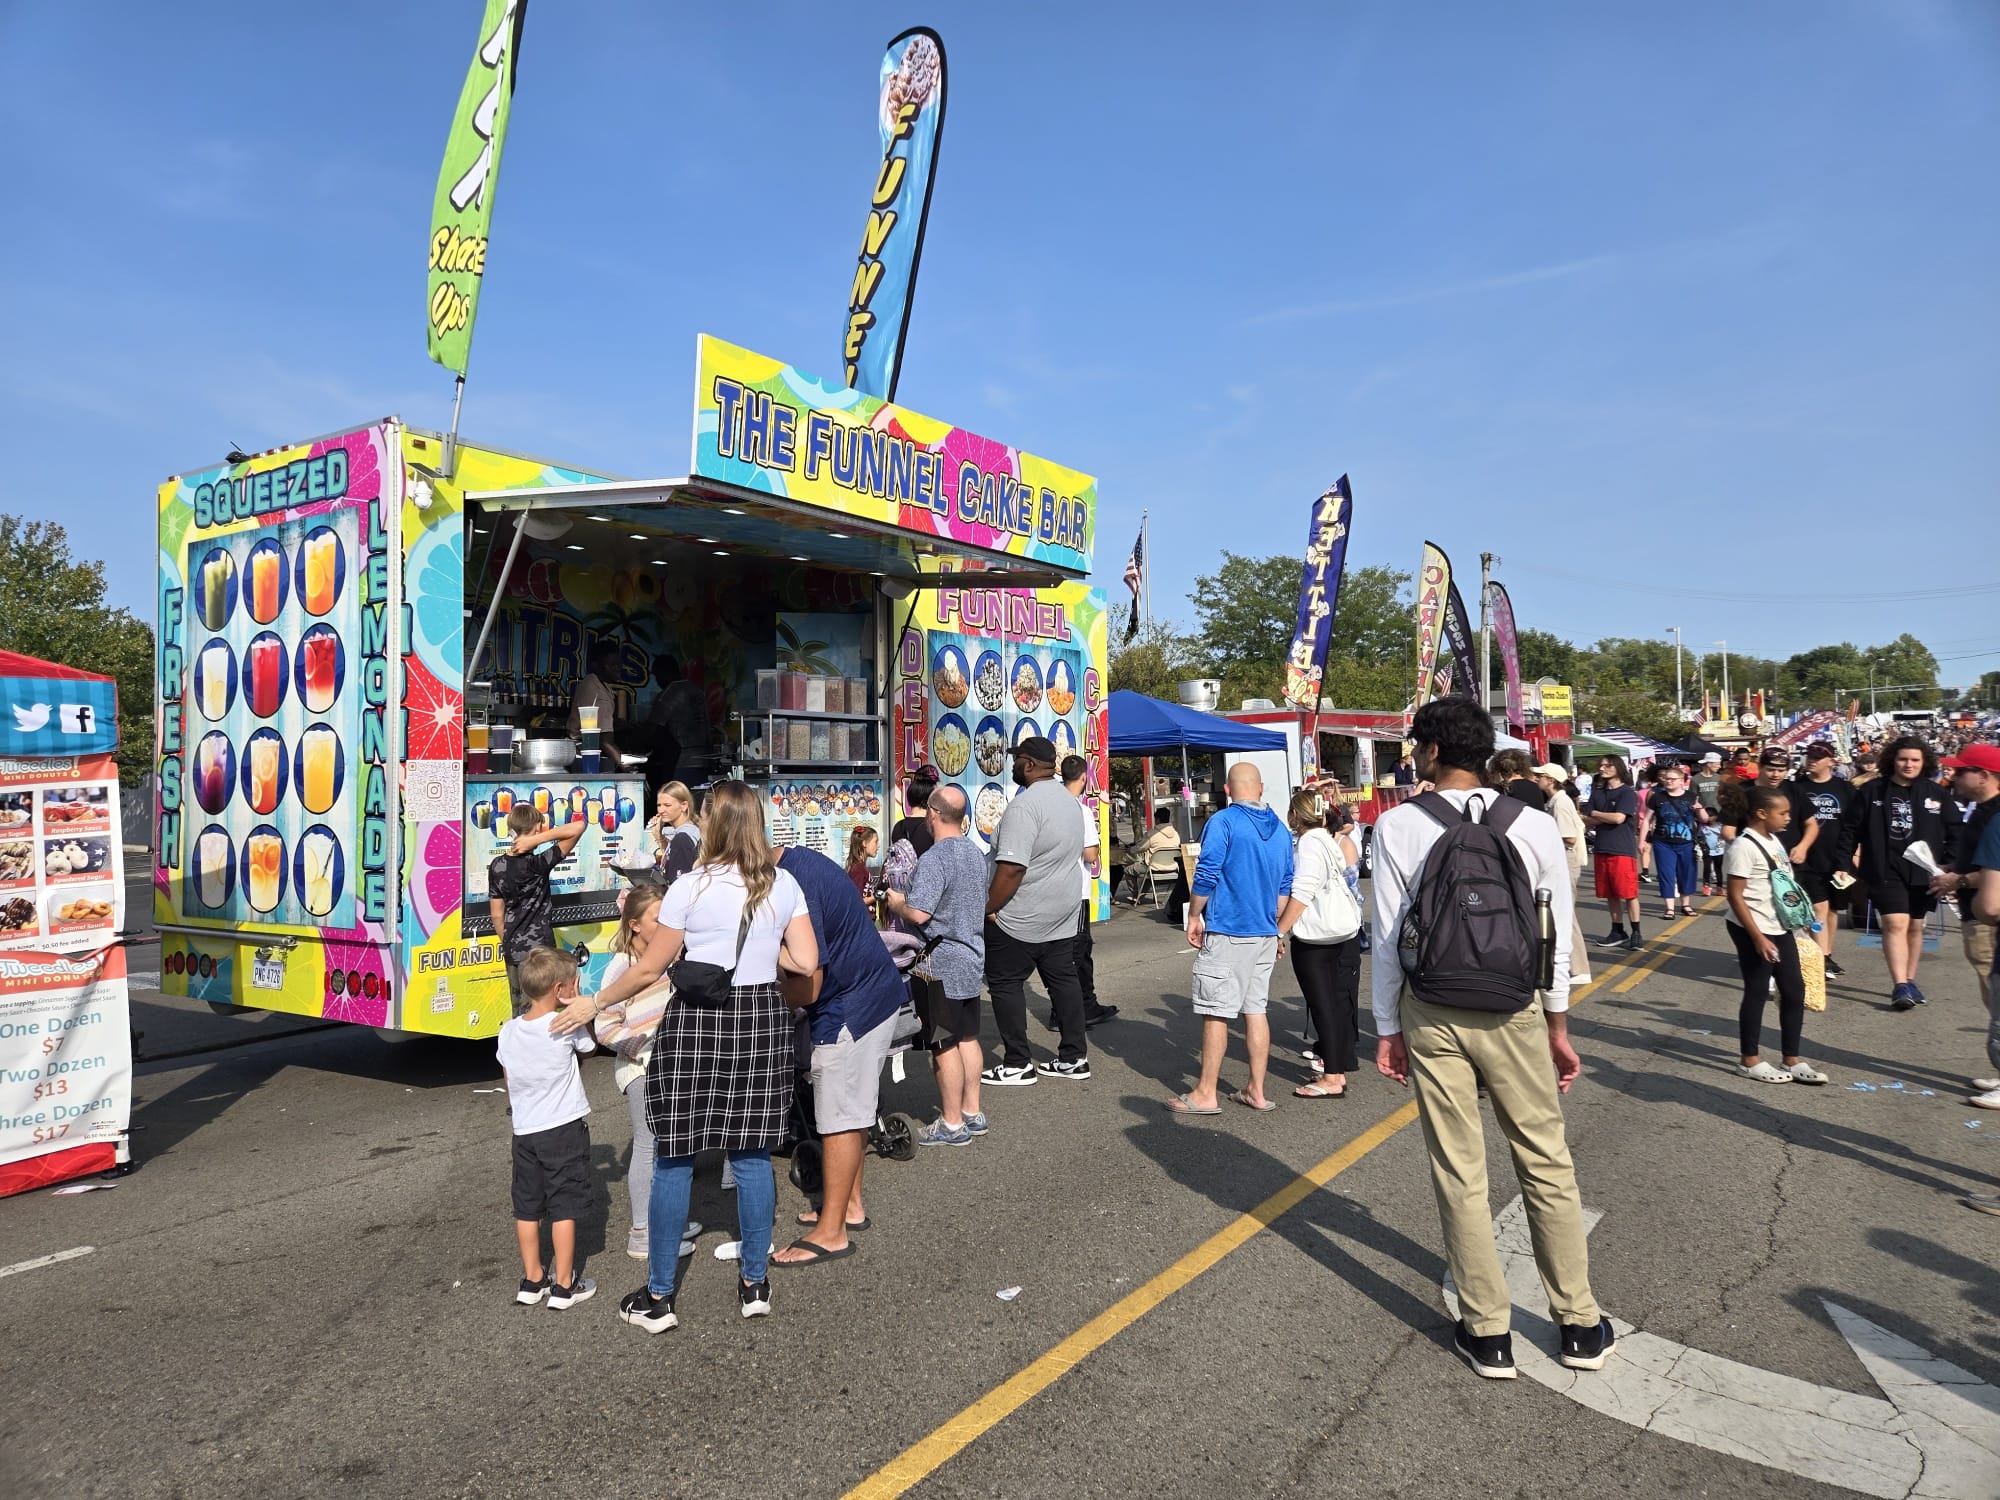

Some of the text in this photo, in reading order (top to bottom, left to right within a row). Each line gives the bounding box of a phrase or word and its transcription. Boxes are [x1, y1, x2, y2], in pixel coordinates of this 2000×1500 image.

[431, 281, 471, 340] Ups
[714, 376, 1088, 554] THE FUNNEL CAKE BAR
[194, 448, 349, 529] SQUEEZED
[937, 587, 1071, 642] FUNNEL
[361, 497, 413, 923] LEMONADE
[160, 587, 183, 870] FRESH
[29, 771, 68, 779] DONUTS
[1812, 799, 1835, 807] WHAT
[51, 826, 82, 834] Raspberry
[1891, 820, 1912, 829] ROUN
[419, 948, 456, 974] FUN
[459, 944, 494, 967] AND
[5, 972, 95, 987] MINI DONUTS
[254, 967, 281, 984] PNG 4726
[0, 1012, 102, 1039] One Dozen
[42, 1036, 65, 1056] $7
[0, 1055, 106, 1084] Two Dozen
[33, 1079, 69, 1101] $13
[0, 1097, 113, 1130] hree Dozen
[32, 1124, 70, 1145] $17
